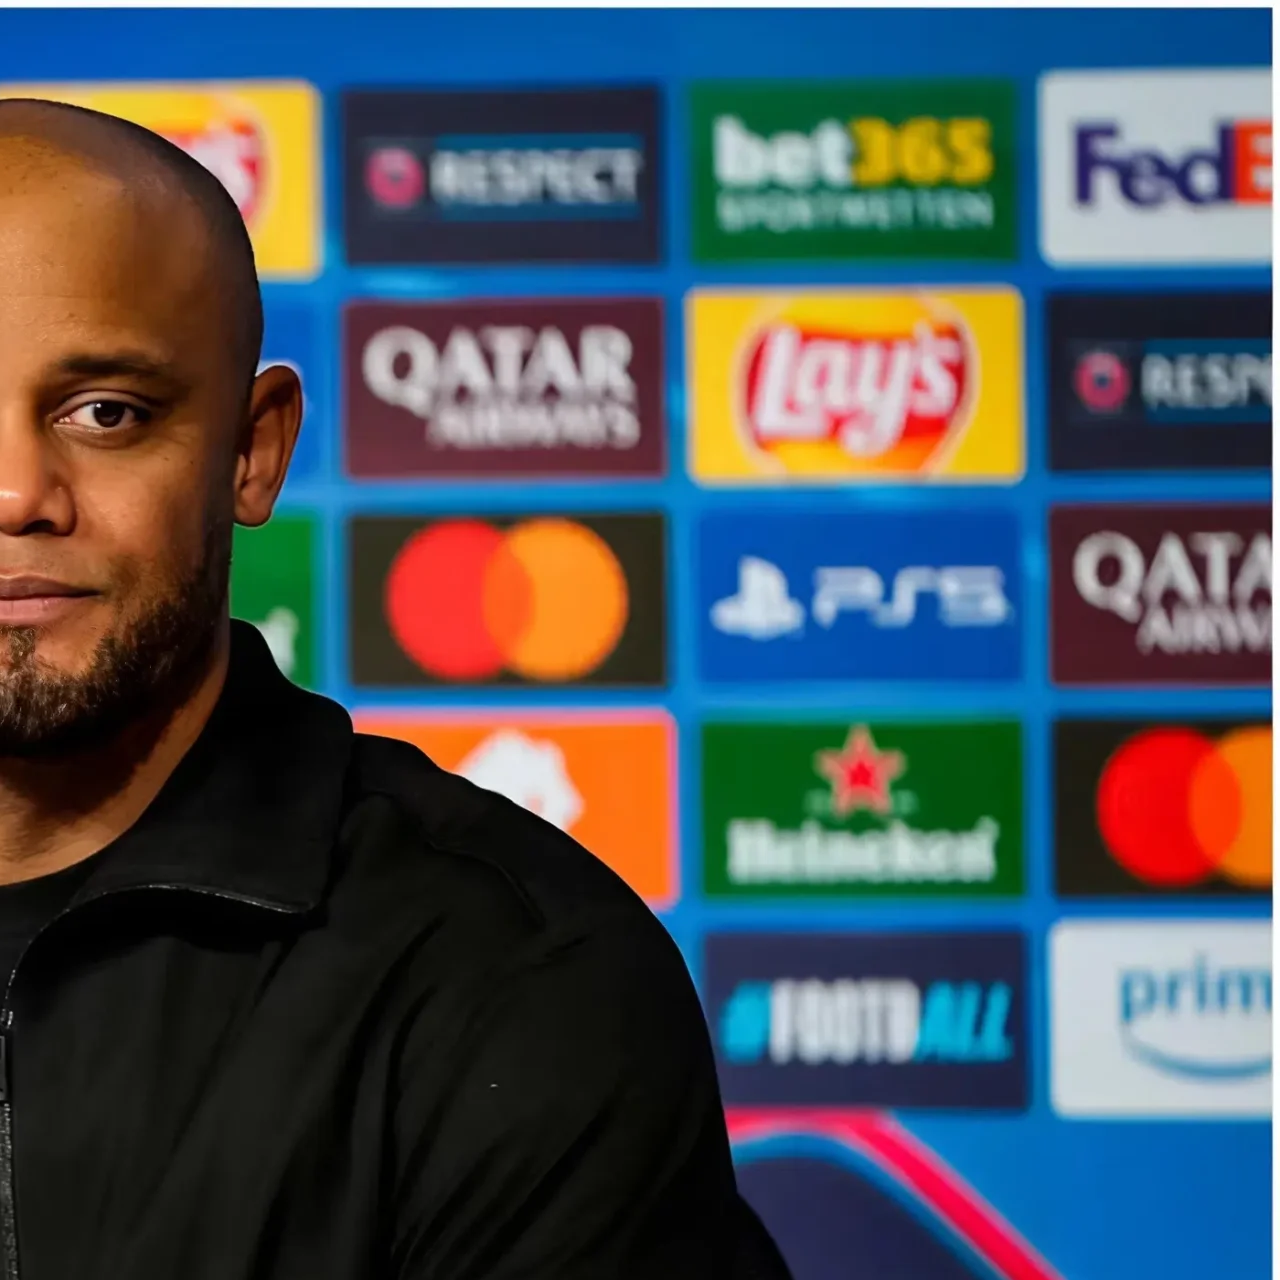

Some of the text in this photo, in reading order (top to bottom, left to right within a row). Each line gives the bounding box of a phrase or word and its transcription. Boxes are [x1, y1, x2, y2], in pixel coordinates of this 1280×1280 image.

[430, 147, 641, 204] RESPECT
[713, 114, 994, 187] bet365
[1074, 118, 1273, 208] FedE
[362, 324, 636, 418] QATAR
[750, 318, 966, 459] Lay's
[812, 565, 1014, 629] PS5
[726, 816, 1001, 885] Heineken
